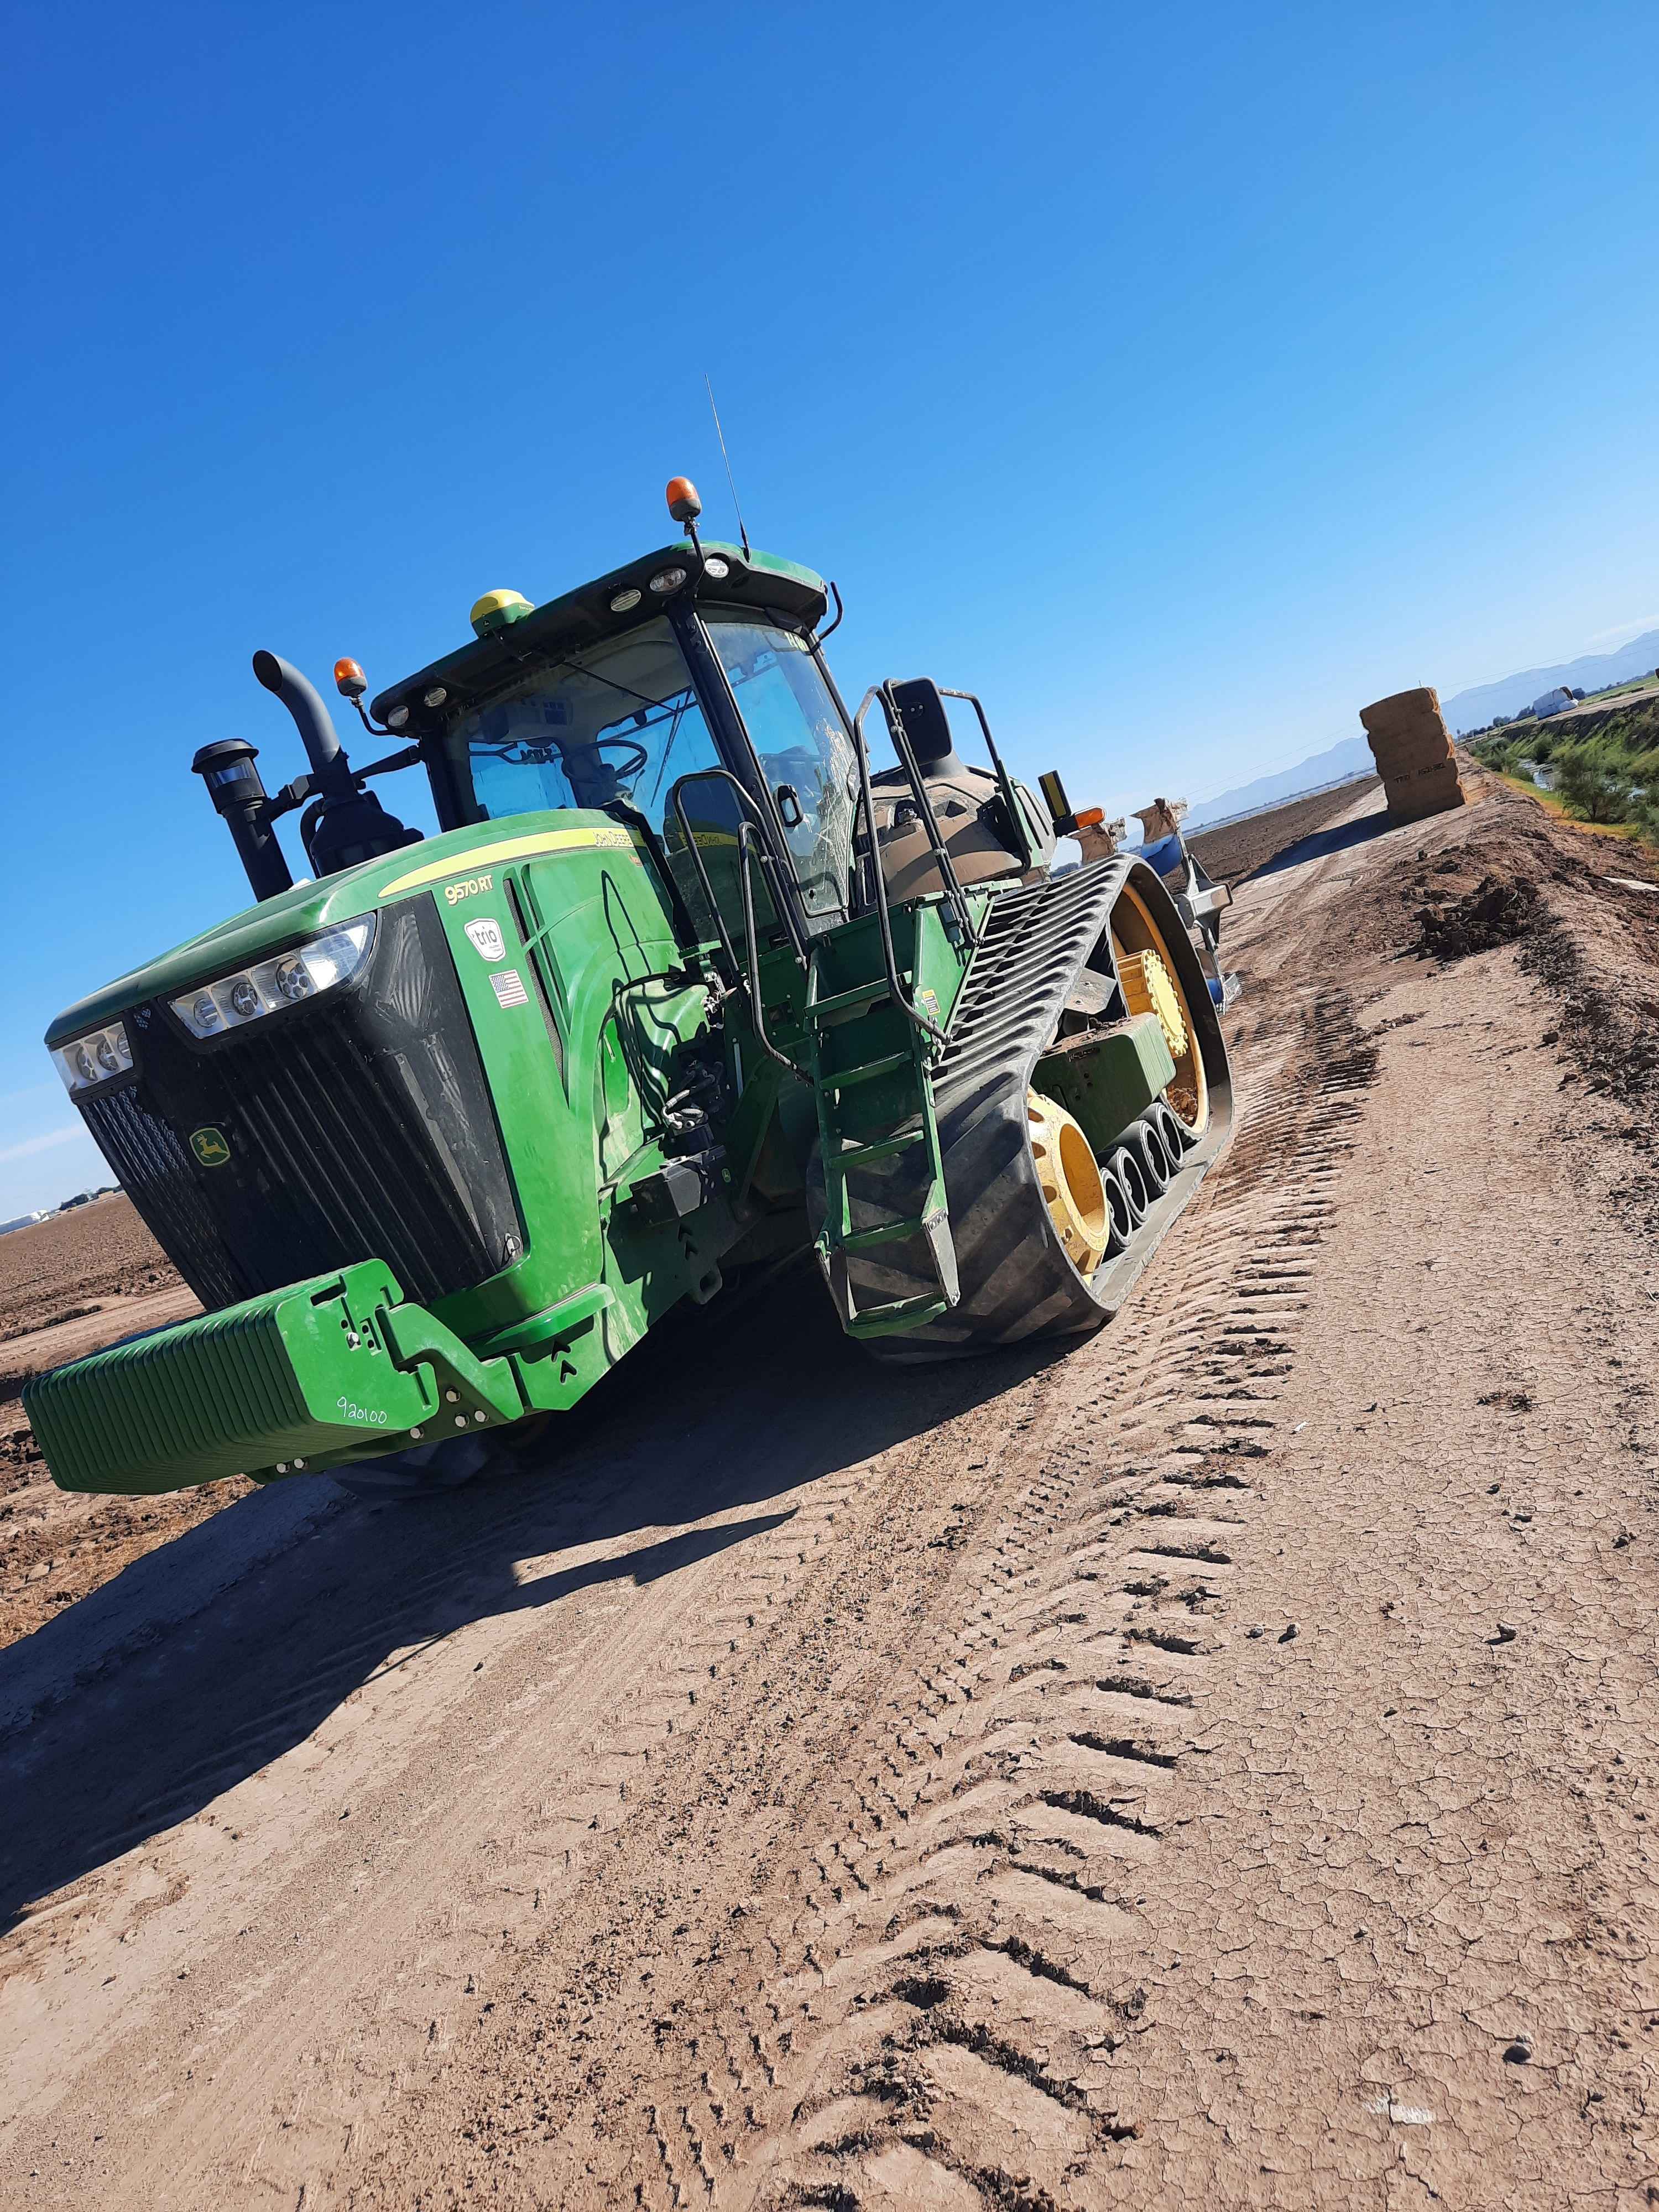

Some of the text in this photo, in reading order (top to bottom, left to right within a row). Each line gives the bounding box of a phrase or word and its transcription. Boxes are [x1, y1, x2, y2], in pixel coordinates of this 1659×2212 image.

[592, 831, 632, 846] JOHN DEERE
[474, 925, 497, 946] trio
[337, 1396, 387, 1424] 920100
